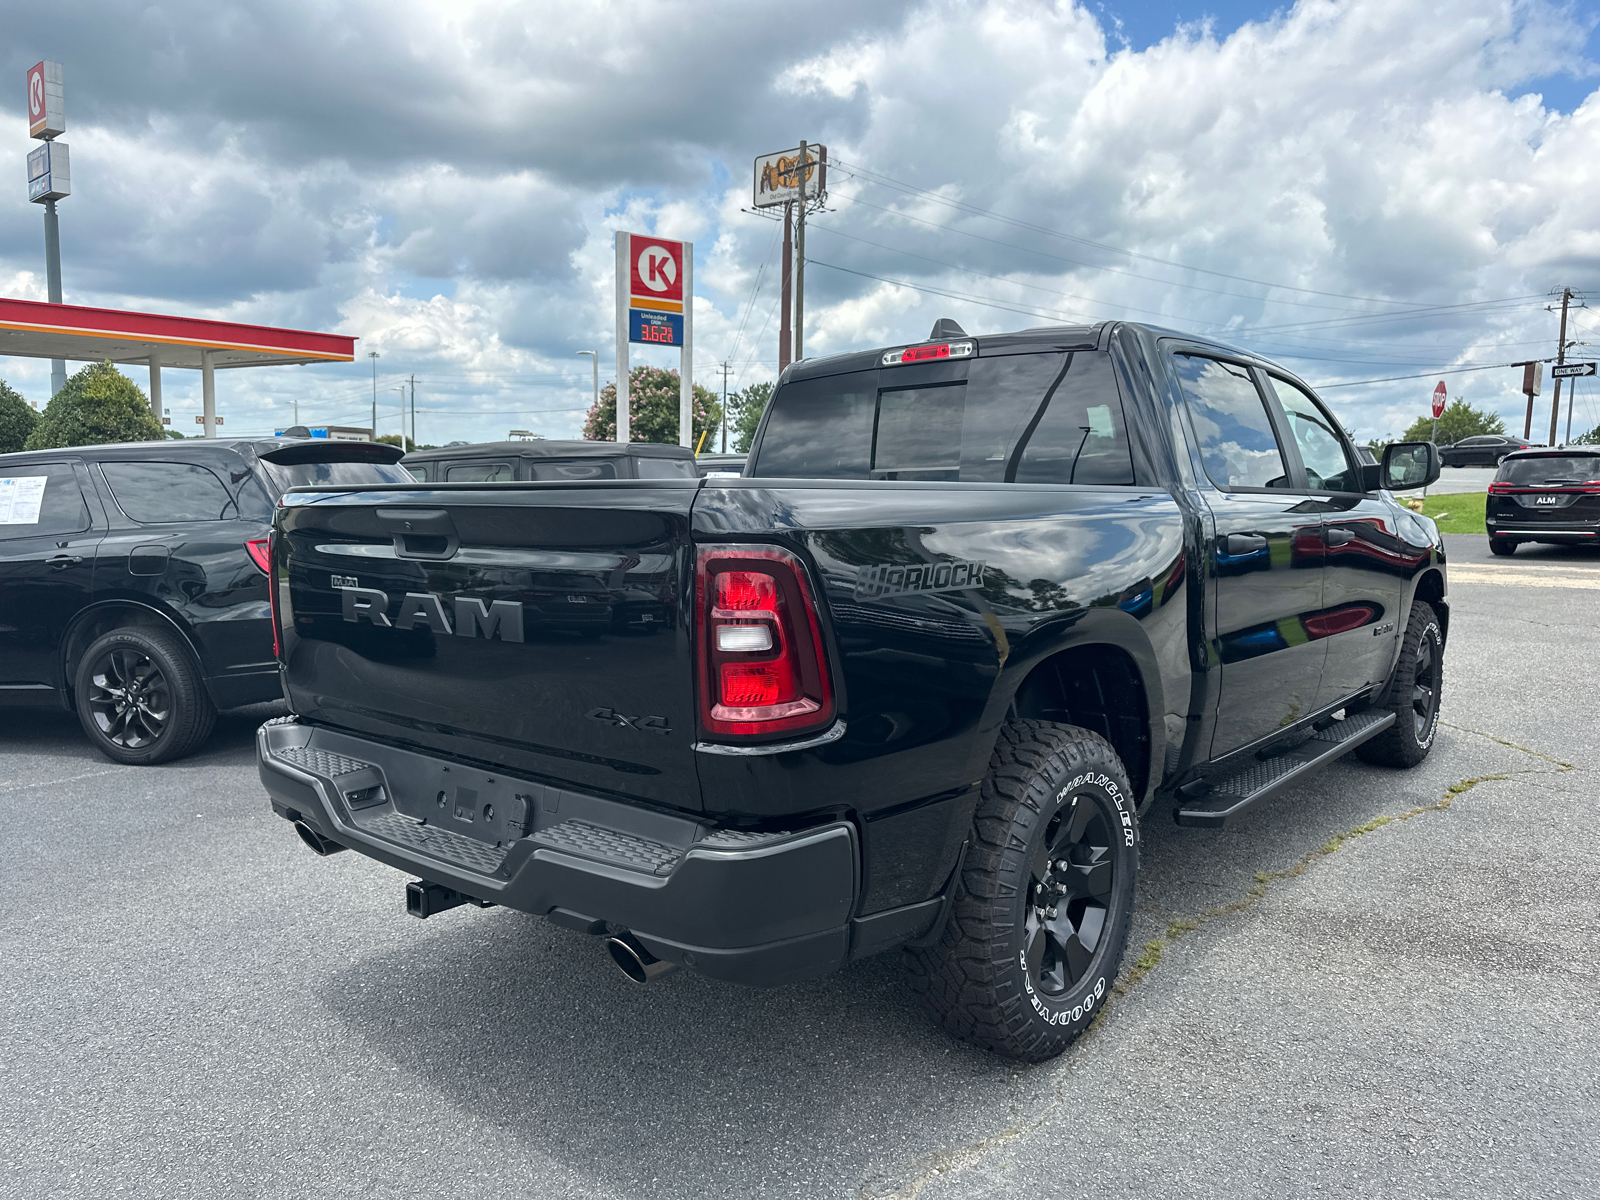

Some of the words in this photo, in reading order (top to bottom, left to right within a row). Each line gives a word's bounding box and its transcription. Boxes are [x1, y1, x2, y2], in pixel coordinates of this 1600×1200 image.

[33, 78, 43, 108] K
[649, 254, 673, 290] K
[641, 313, 667, 321] Unleaded
[1432, 392, 1446, 407] STOP
[1536, 496, 1556, 504] ALM
[341, 586, 525, 643] RAM
[1056, 772, 1134, 847] WRANGLER
[1020, 949, 1106, 1026] GOODYEAR
